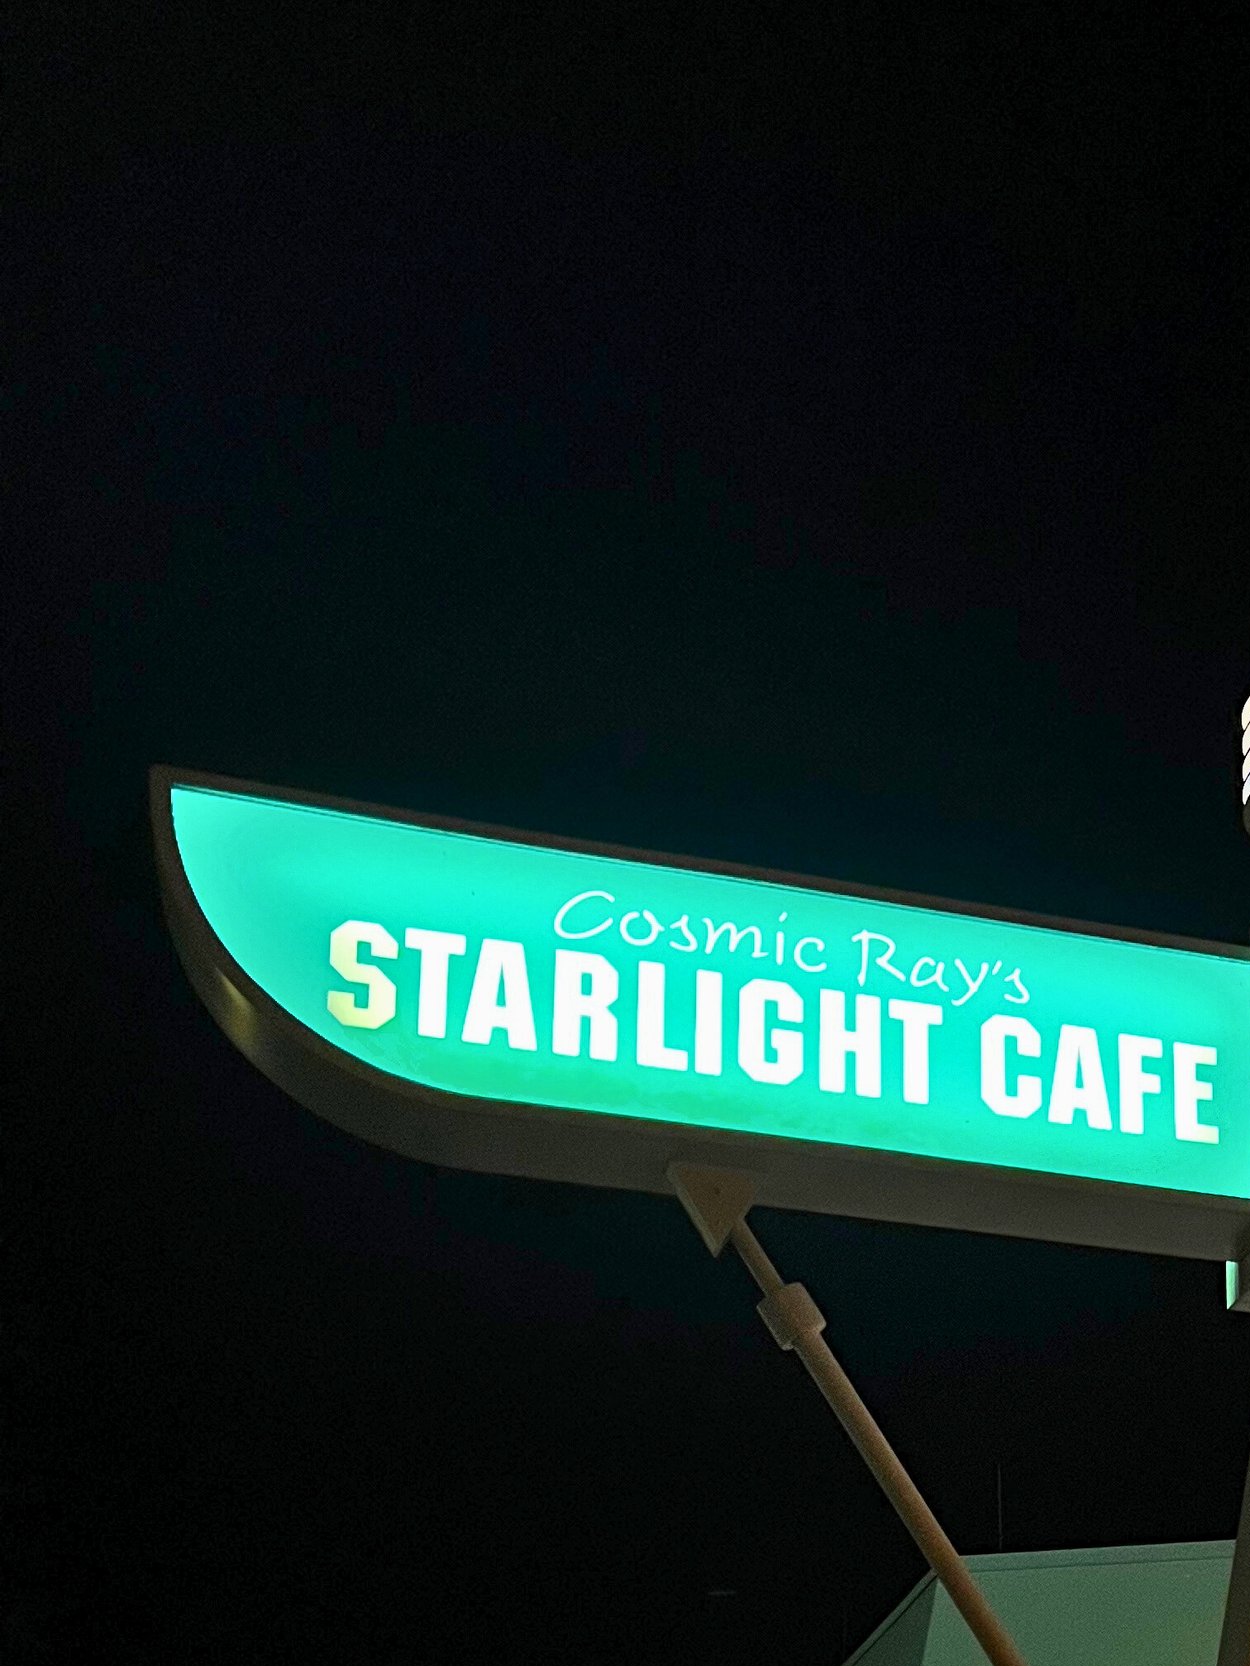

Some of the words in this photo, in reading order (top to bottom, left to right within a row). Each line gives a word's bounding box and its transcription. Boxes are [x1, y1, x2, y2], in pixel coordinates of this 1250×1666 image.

[326, 919, 944, 1106] STARLIGHT
[979, 1013, 1220, 1145] CAFE
[553, 889, 828, 973] Cosmic
[850, 929, 1031, 1007] Ray's
